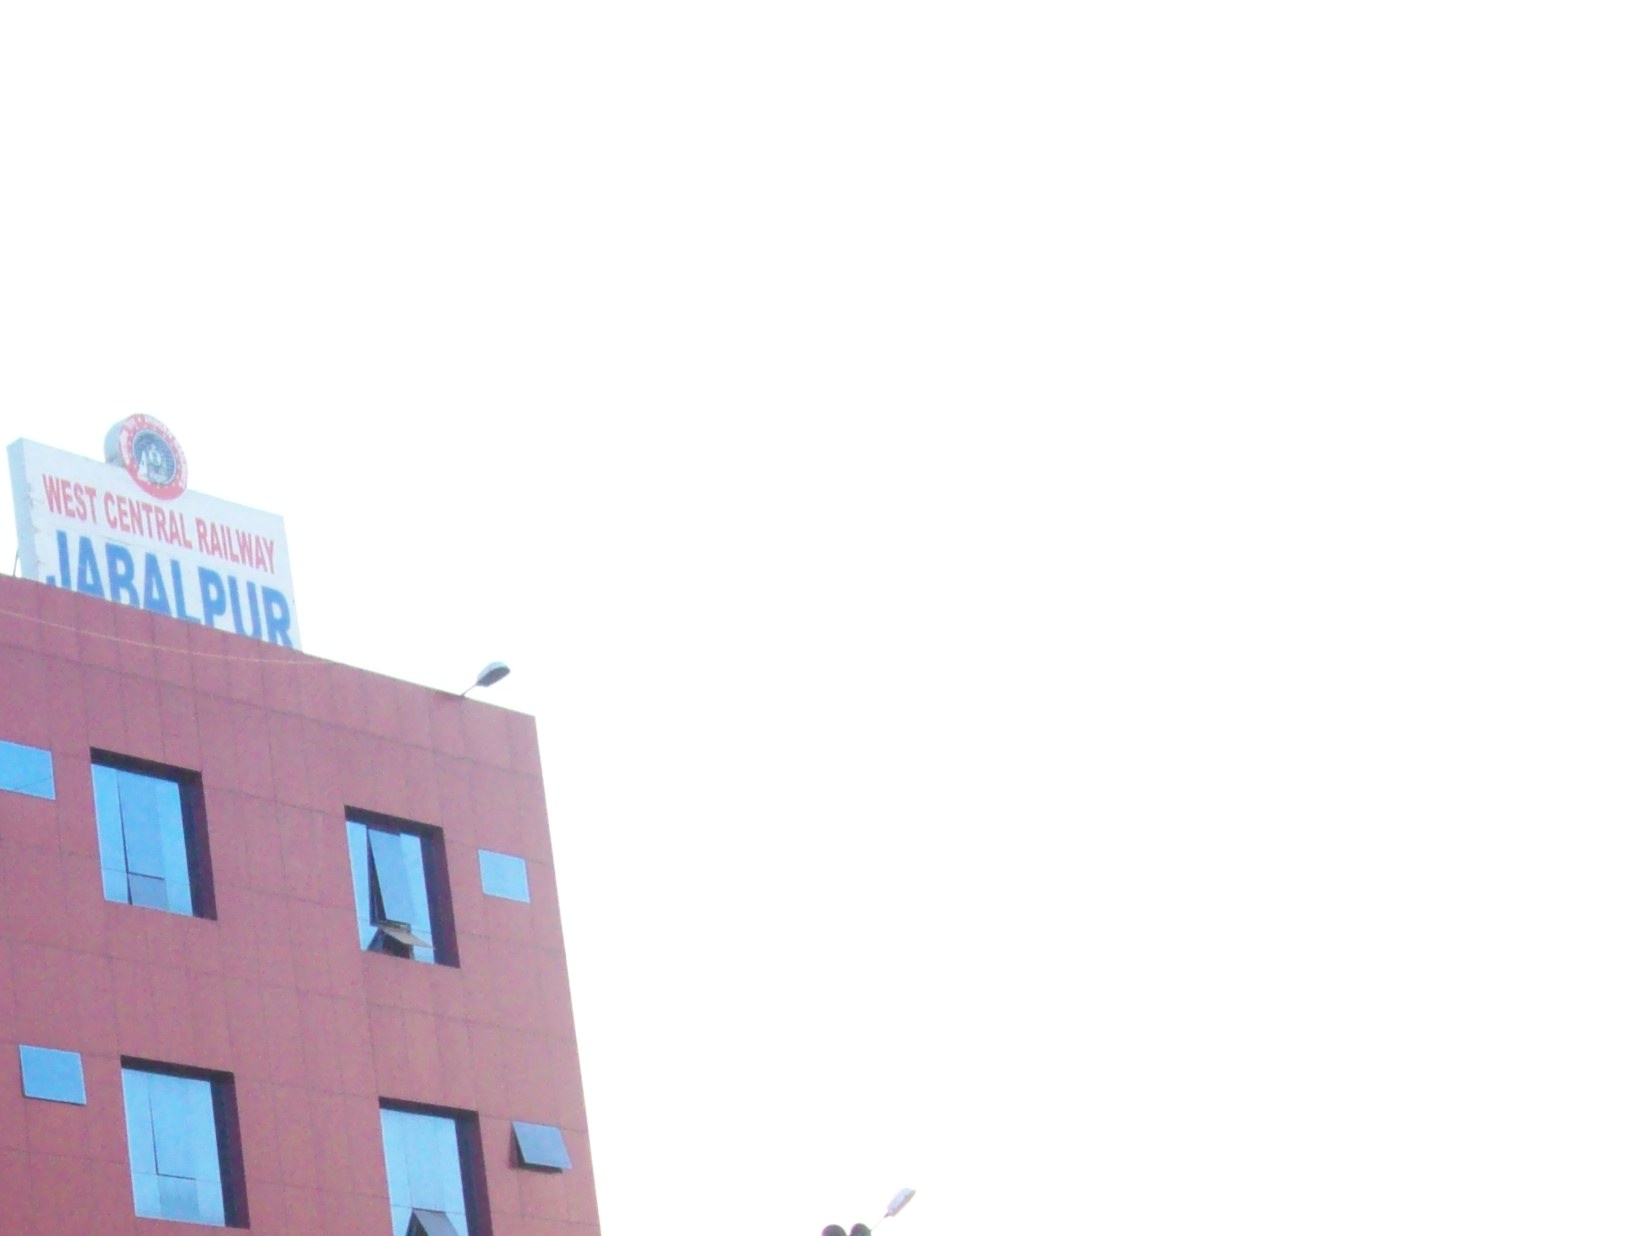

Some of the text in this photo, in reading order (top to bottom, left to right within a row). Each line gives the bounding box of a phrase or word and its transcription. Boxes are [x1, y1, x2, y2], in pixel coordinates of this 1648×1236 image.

[42, 473, 274, 575] WEST CENTRAL RAILWAY
[46, 529, 294, 649] JABALPUR
